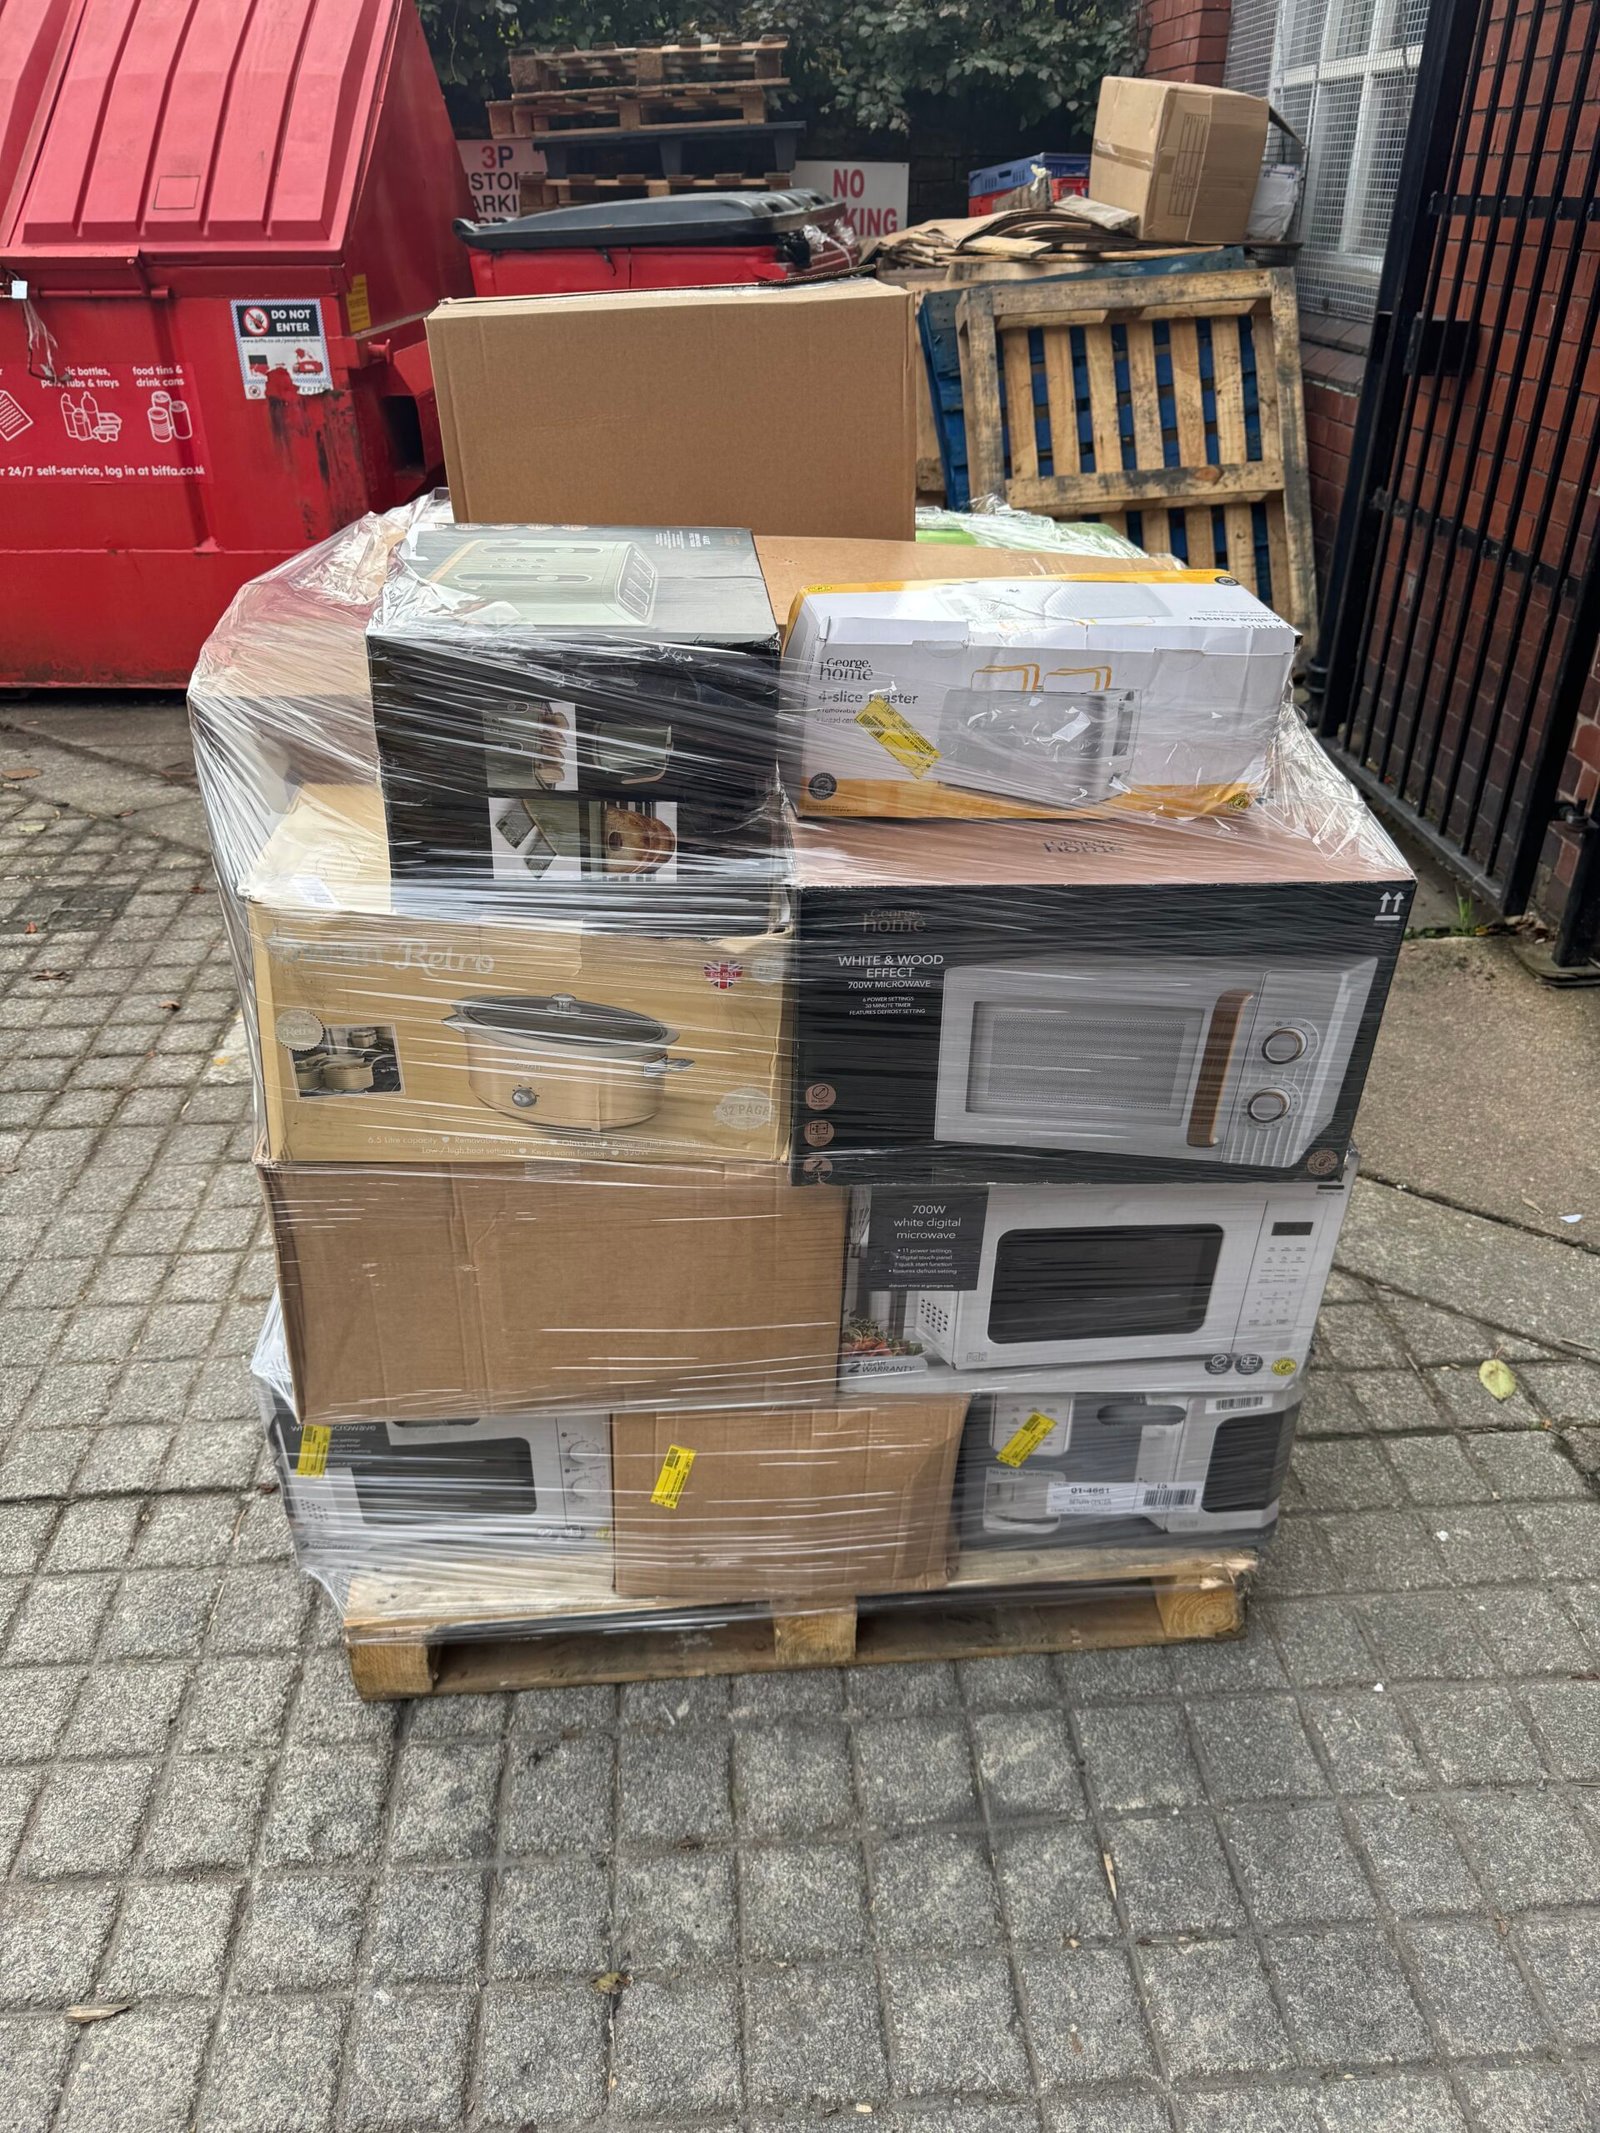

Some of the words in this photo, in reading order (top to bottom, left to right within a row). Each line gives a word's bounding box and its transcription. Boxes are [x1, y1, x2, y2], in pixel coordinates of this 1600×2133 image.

[481, 146, 514, 169] 3P
[833, 169, 865, 198] NO
[843, 208, 897, 237] KING
[271, 310, 287, 320] DO
[289, 310, 311, 319] NOT
[276, 322, 311, 332] ENTER
[77, 366, 111, 377] bottles,
[132, 366, 154, 375] food
[157, 365, 174, 375] tins
[175, 365, 183, 374] &
[87, 378, 95, 387] &
[96, 378, 120, 389] trays
[136, 377, 160, 387] drink
[8, 466, 33, 477] 24/7
[37, 465, 104, 478] self-service,
[105, 464, 123, 478] log
[124, 465, 136, 476] in
[137, 465, 150, 476] at
[819, 662, 873, 681] home
[819, 690, 863, 703] 4-slice
[868, 691, 919, 704] taster
[838, 955, 880, 966] WHITE
[884, 955, 894, 966] &
[897, 954, 944, 965] WOOD
[866, 968, 915, 978] EFFECT
[848, 981, 873, 989] 700W
[875, 980, 931, 988] MICROWAVE
[368, 1136, 382, 1144] 6.5
[402, 1136, 437, 1145] capacity
[577, 1148, 606, 1157] function
[912, 1205, 947, 1215] 700W
[893, 1217, 924, 1227] white
[926, 1217, 961, 1229] digital
[896, 1230, 956, 1239] microwave
[848, 1361, 861, 1373] 2
[862, 1365, 915, 1373] WARRANTY
